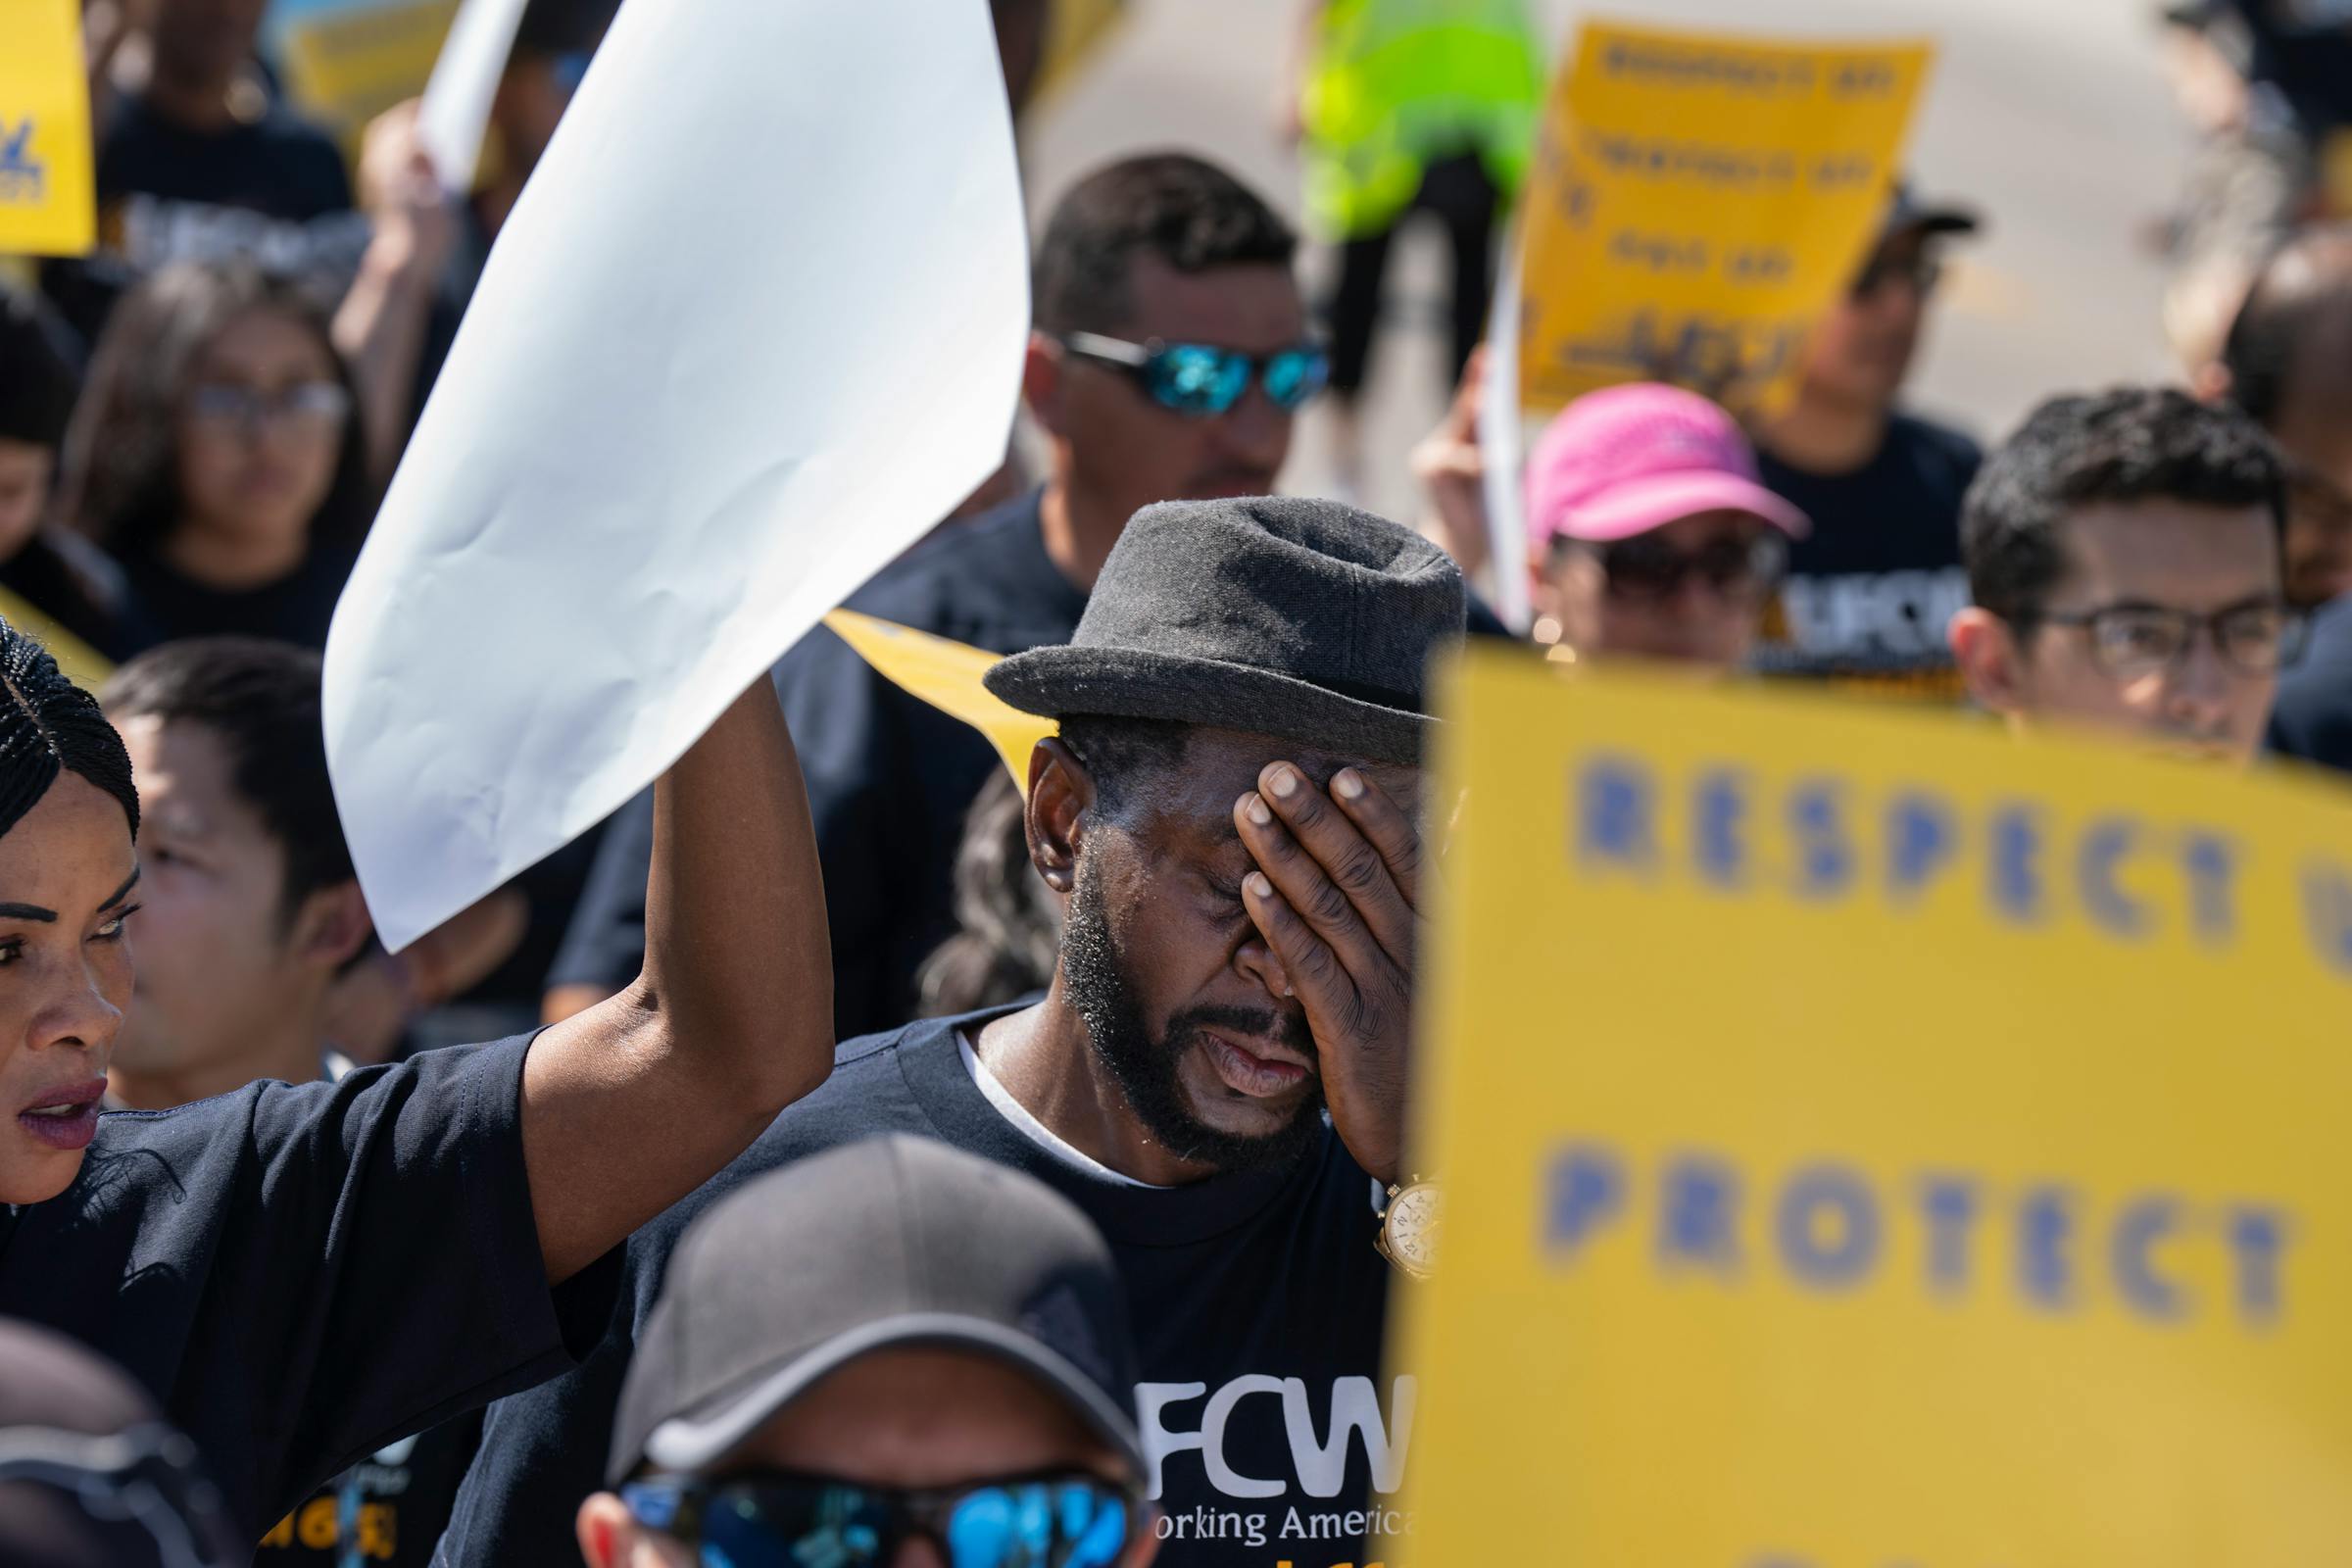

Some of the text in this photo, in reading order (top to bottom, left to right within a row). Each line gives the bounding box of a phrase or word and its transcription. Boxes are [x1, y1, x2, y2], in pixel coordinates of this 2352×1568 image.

[1576, 753, 2244, 947] RESPECT
[1542, 1142, 2293, 1333] PROTECT
[1134, 1374, 1417, 1500] FCW
[1155, 1505, 1267, 1546] orking
